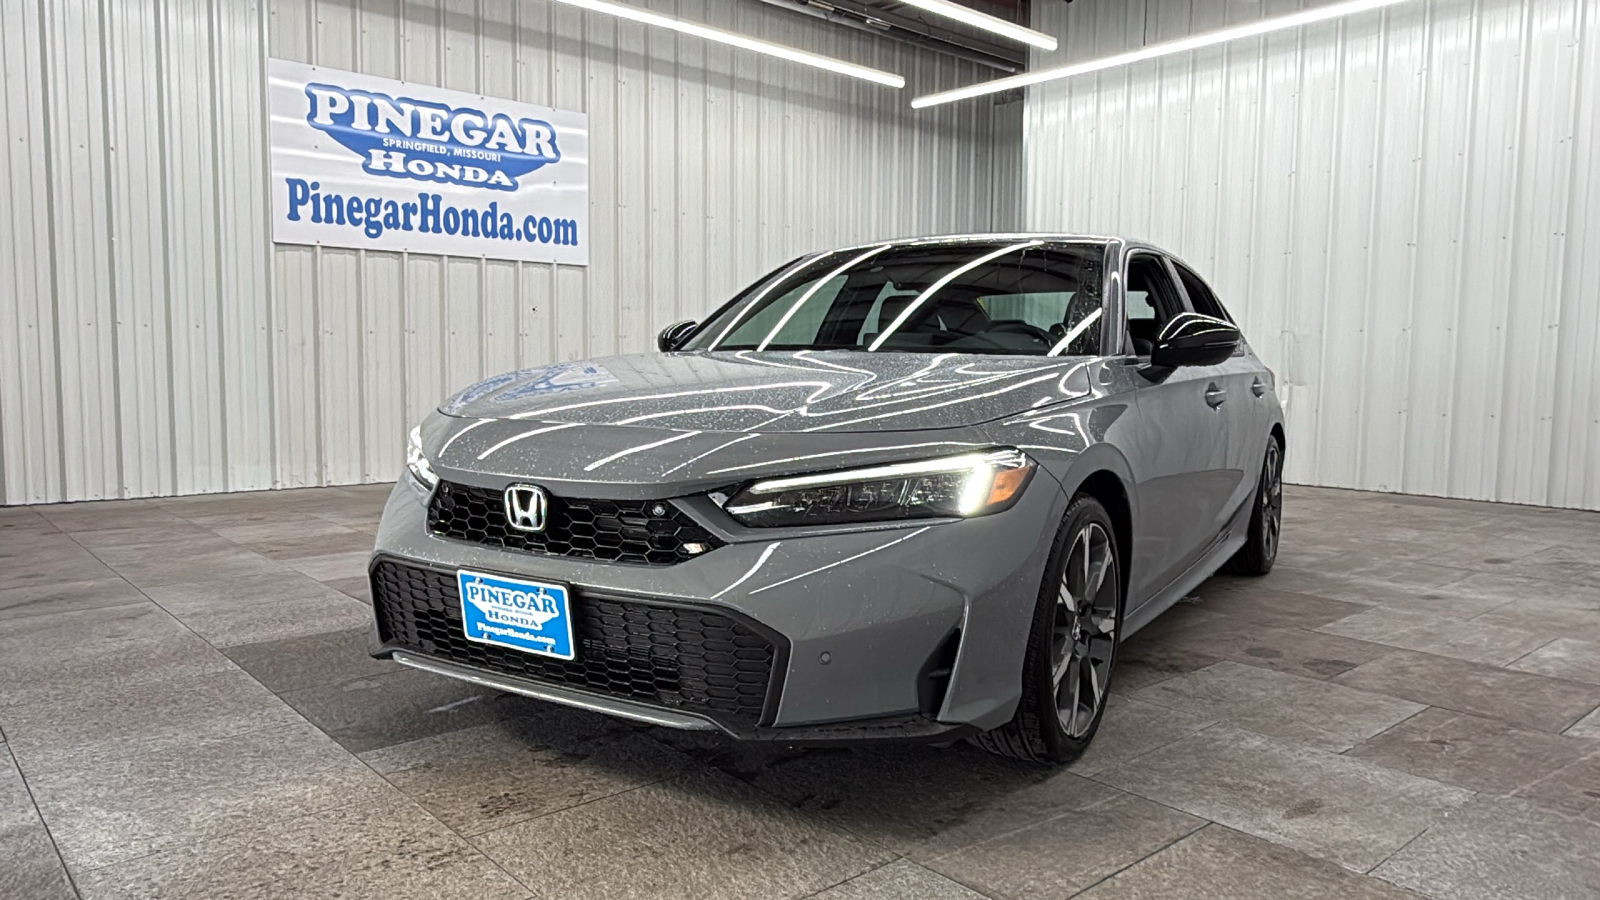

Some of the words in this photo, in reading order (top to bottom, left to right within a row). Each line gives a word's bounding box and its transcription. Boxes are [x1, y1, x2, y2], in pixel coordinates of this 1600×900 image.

[311, 88, 556, 159] PINEGAR
[382, 137, 451, 157] SPRINGFIELD,
[453, 147, 501, 163] MISSOURI
[367, 149, 514, 187] HONDA
[285, 178, 578, 246] PinegarHonda.com
[469, 586, 556, 614] PINEGAR
[488, 610, 539, 627] HONDA
[476, 622, 556, 645] PinegarHonda.com
